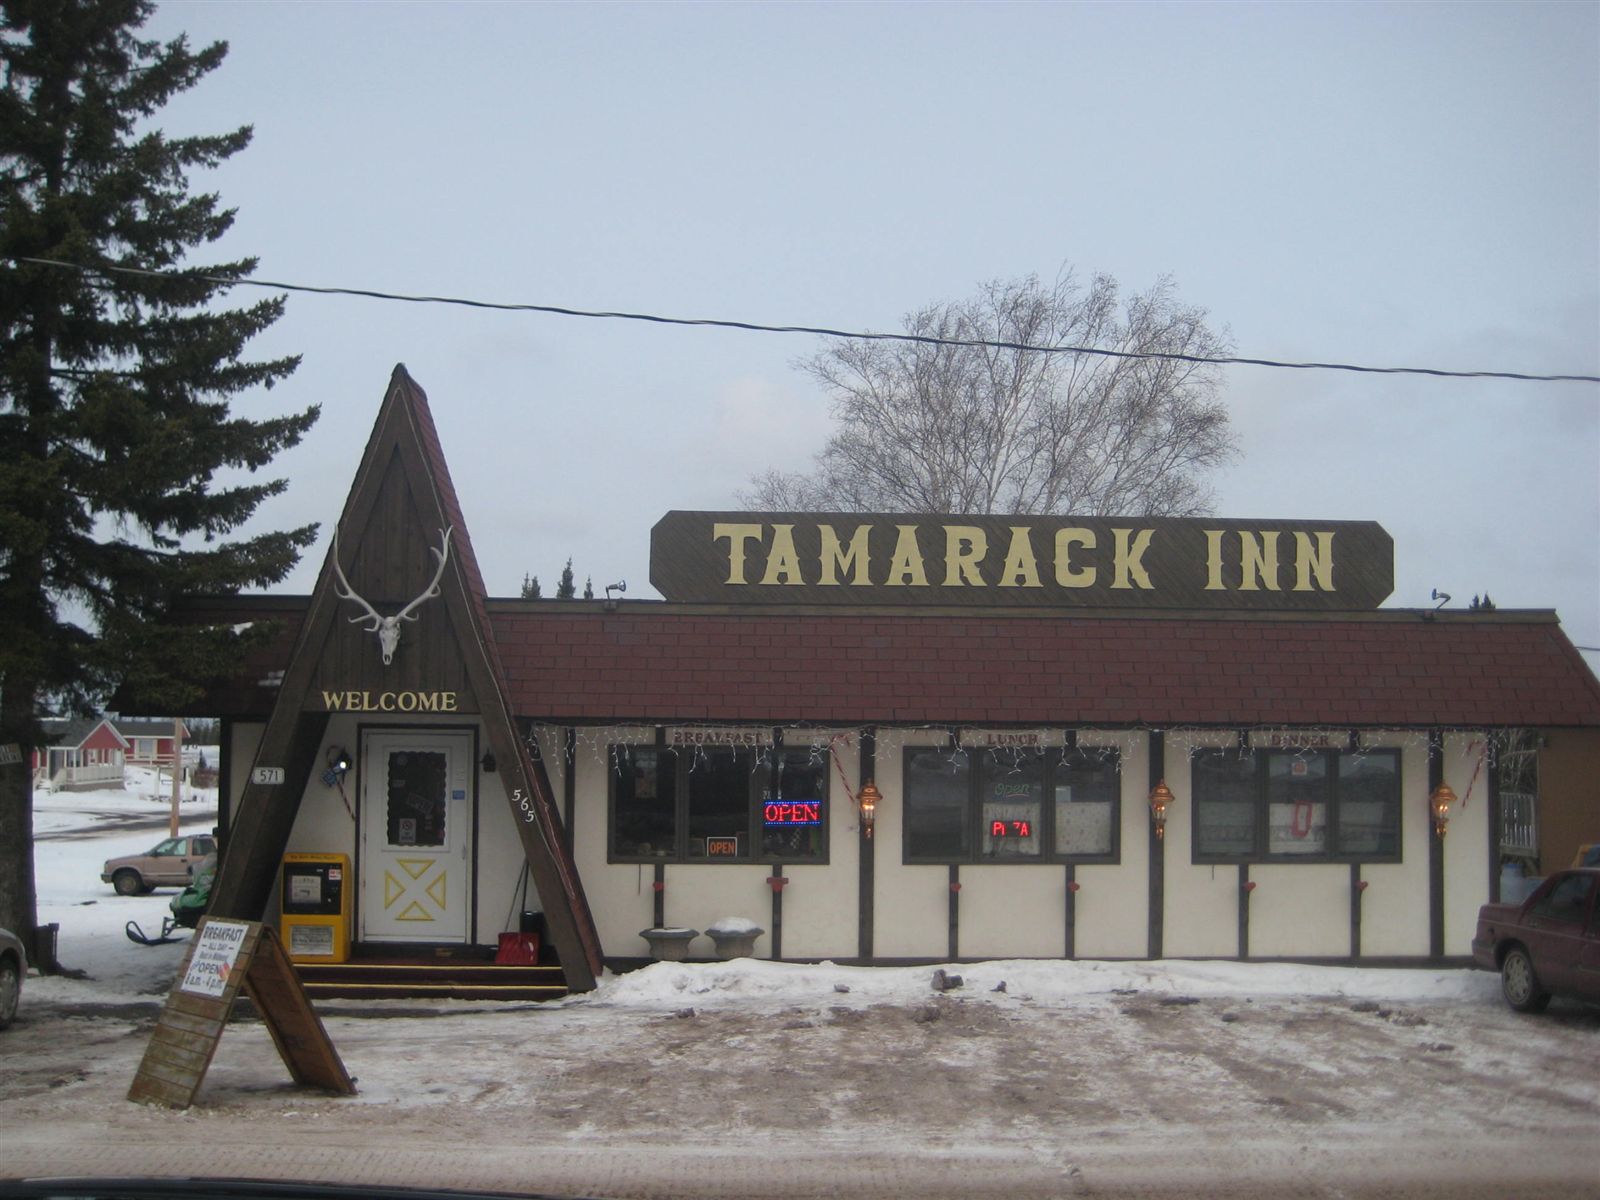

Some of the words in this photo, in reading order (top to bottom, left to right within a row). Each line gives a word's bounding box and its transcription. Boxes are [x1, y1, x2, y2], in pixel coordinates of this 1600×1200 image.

[713, 523, 1156, 590] TAMARACK
[1203, 529, 1337, 592] INN
[322, 690, 457, 712] WELCOME
[987, 733, 1039, 745] LUNCH
[260, 769, 279, 782] 571
[511, 789, 535, 823] 565
[765, 804, 819, 822] OPEN
[709, 841, 736, 854] OPEN
[203, 926, 244, 942] BREAKFAST
[198, 962, 220, 975] OPEN
